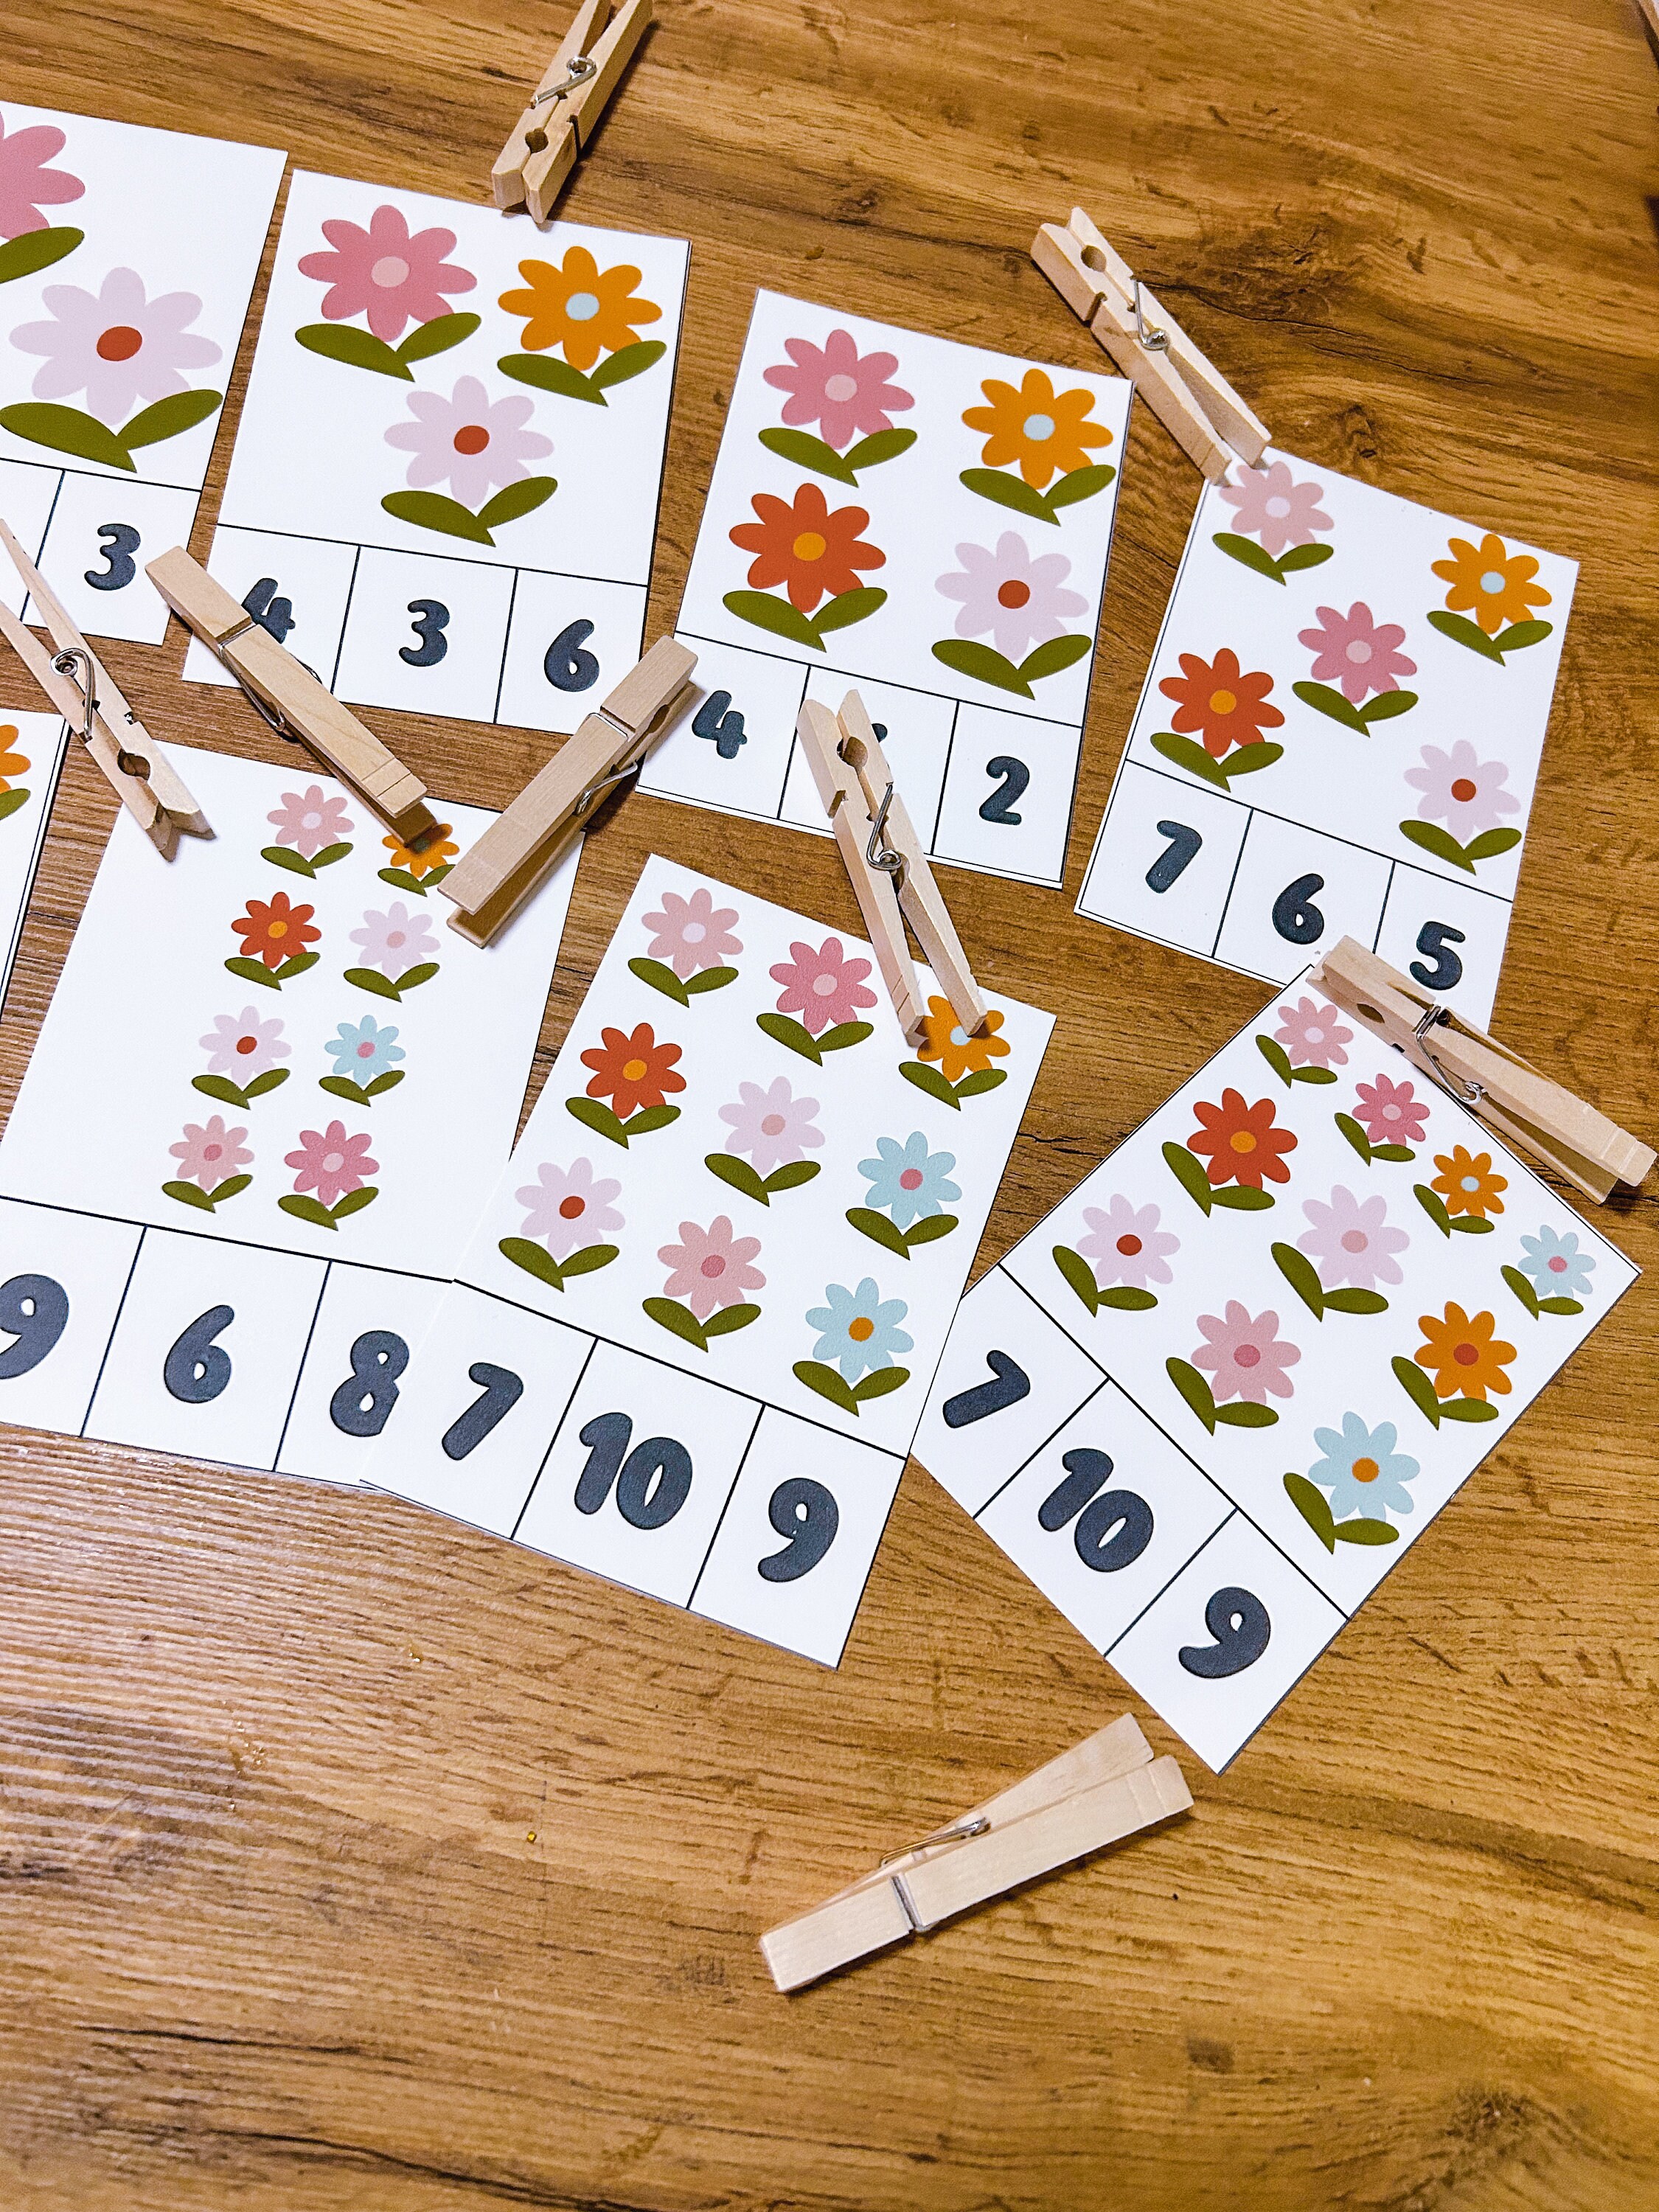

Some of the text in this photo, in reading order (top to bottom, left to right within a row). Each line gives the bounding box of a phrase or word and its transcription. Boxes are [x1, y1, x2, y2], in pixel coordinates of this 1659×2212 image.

[84, 524, 141, 591] 3
[242, 577, 599, 692] 4 3 6
[692, 690, 1029, 825] 4 2
[1146, 820, 1465, 990] 7 6 5
[0, 1274, 409, 1437] 9 6 8
[442, 1362, 839, 1583] 7 10 9
[943, 1350, 1271, 1679] 7 10 9
